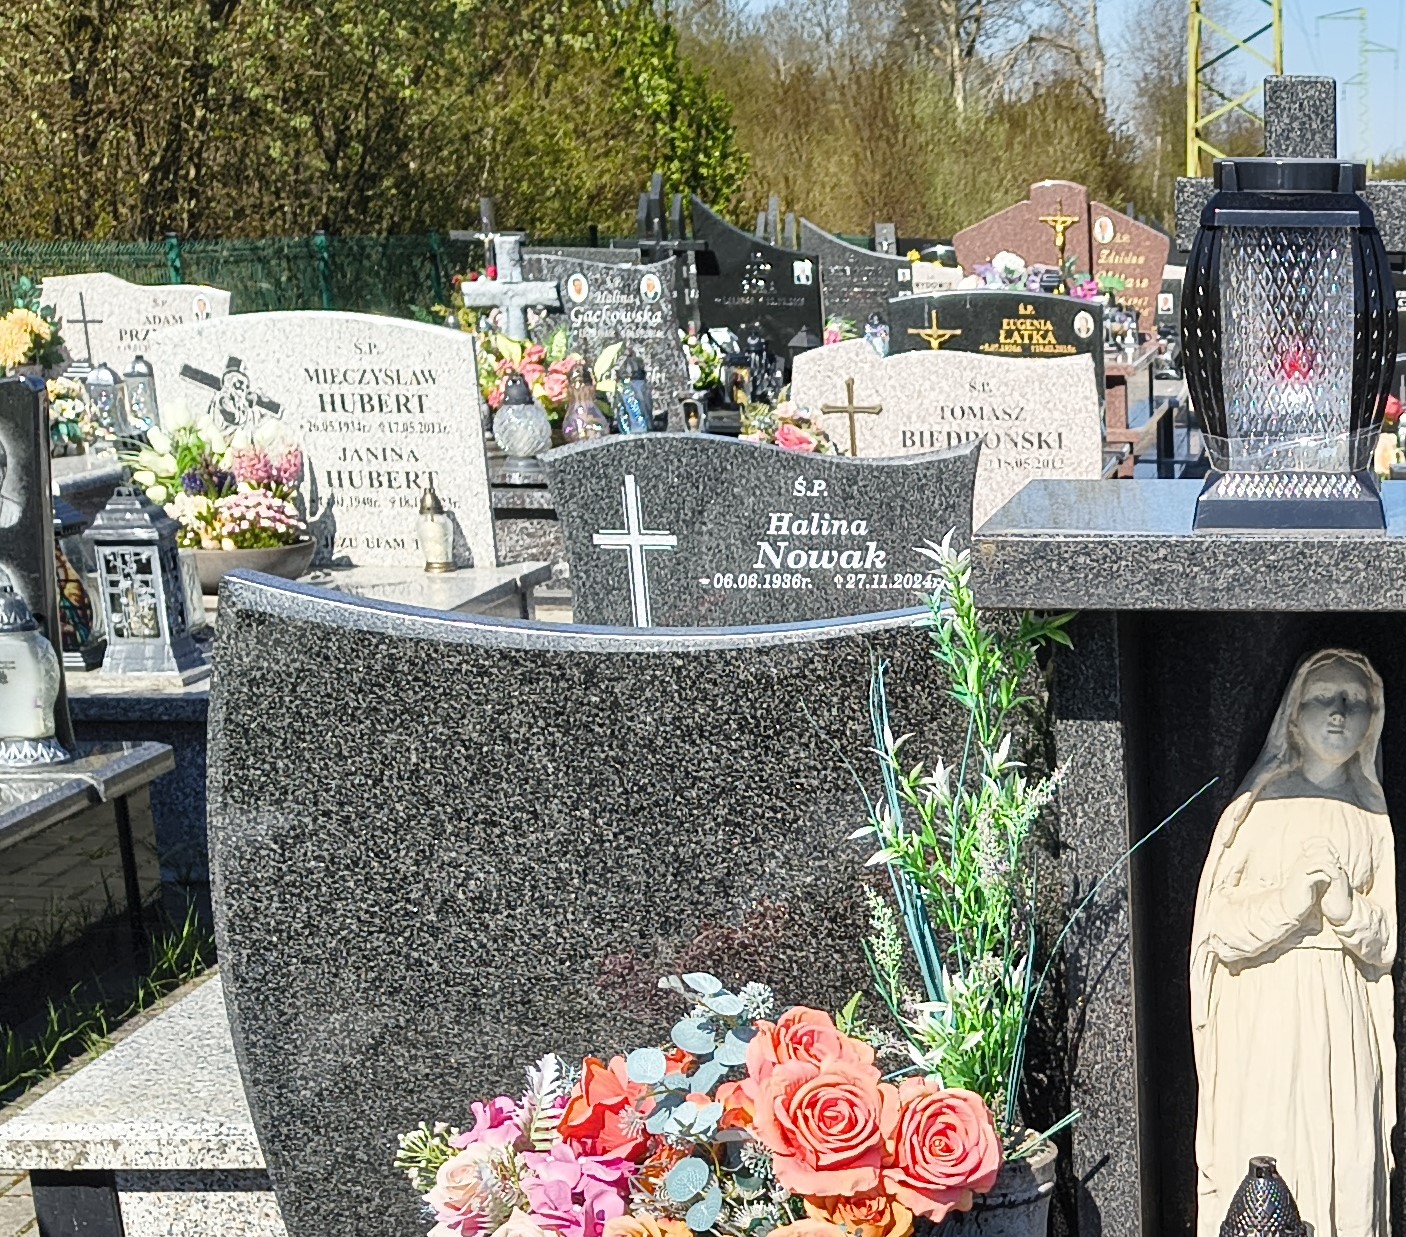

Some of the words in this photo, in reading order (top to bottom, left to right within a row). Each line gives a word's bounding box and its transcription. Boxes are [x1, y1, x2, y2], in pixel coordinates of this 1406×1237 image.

[1002, 318, 1054, 330] EUGENIA
[999, 329, 1057, 344] ŁATKA
[318, 392, 429, 414] HUBERT
[939, 405, 1027, 422] TOMASZ
[338, 447, 420, 463] JANINA
[326, 470, 439, 490] HUBERT
[793, 475, 829, 498] Ś.P.
[766, 512, 869, 536] Halina
[753, 541, 888, 570] Nowak
